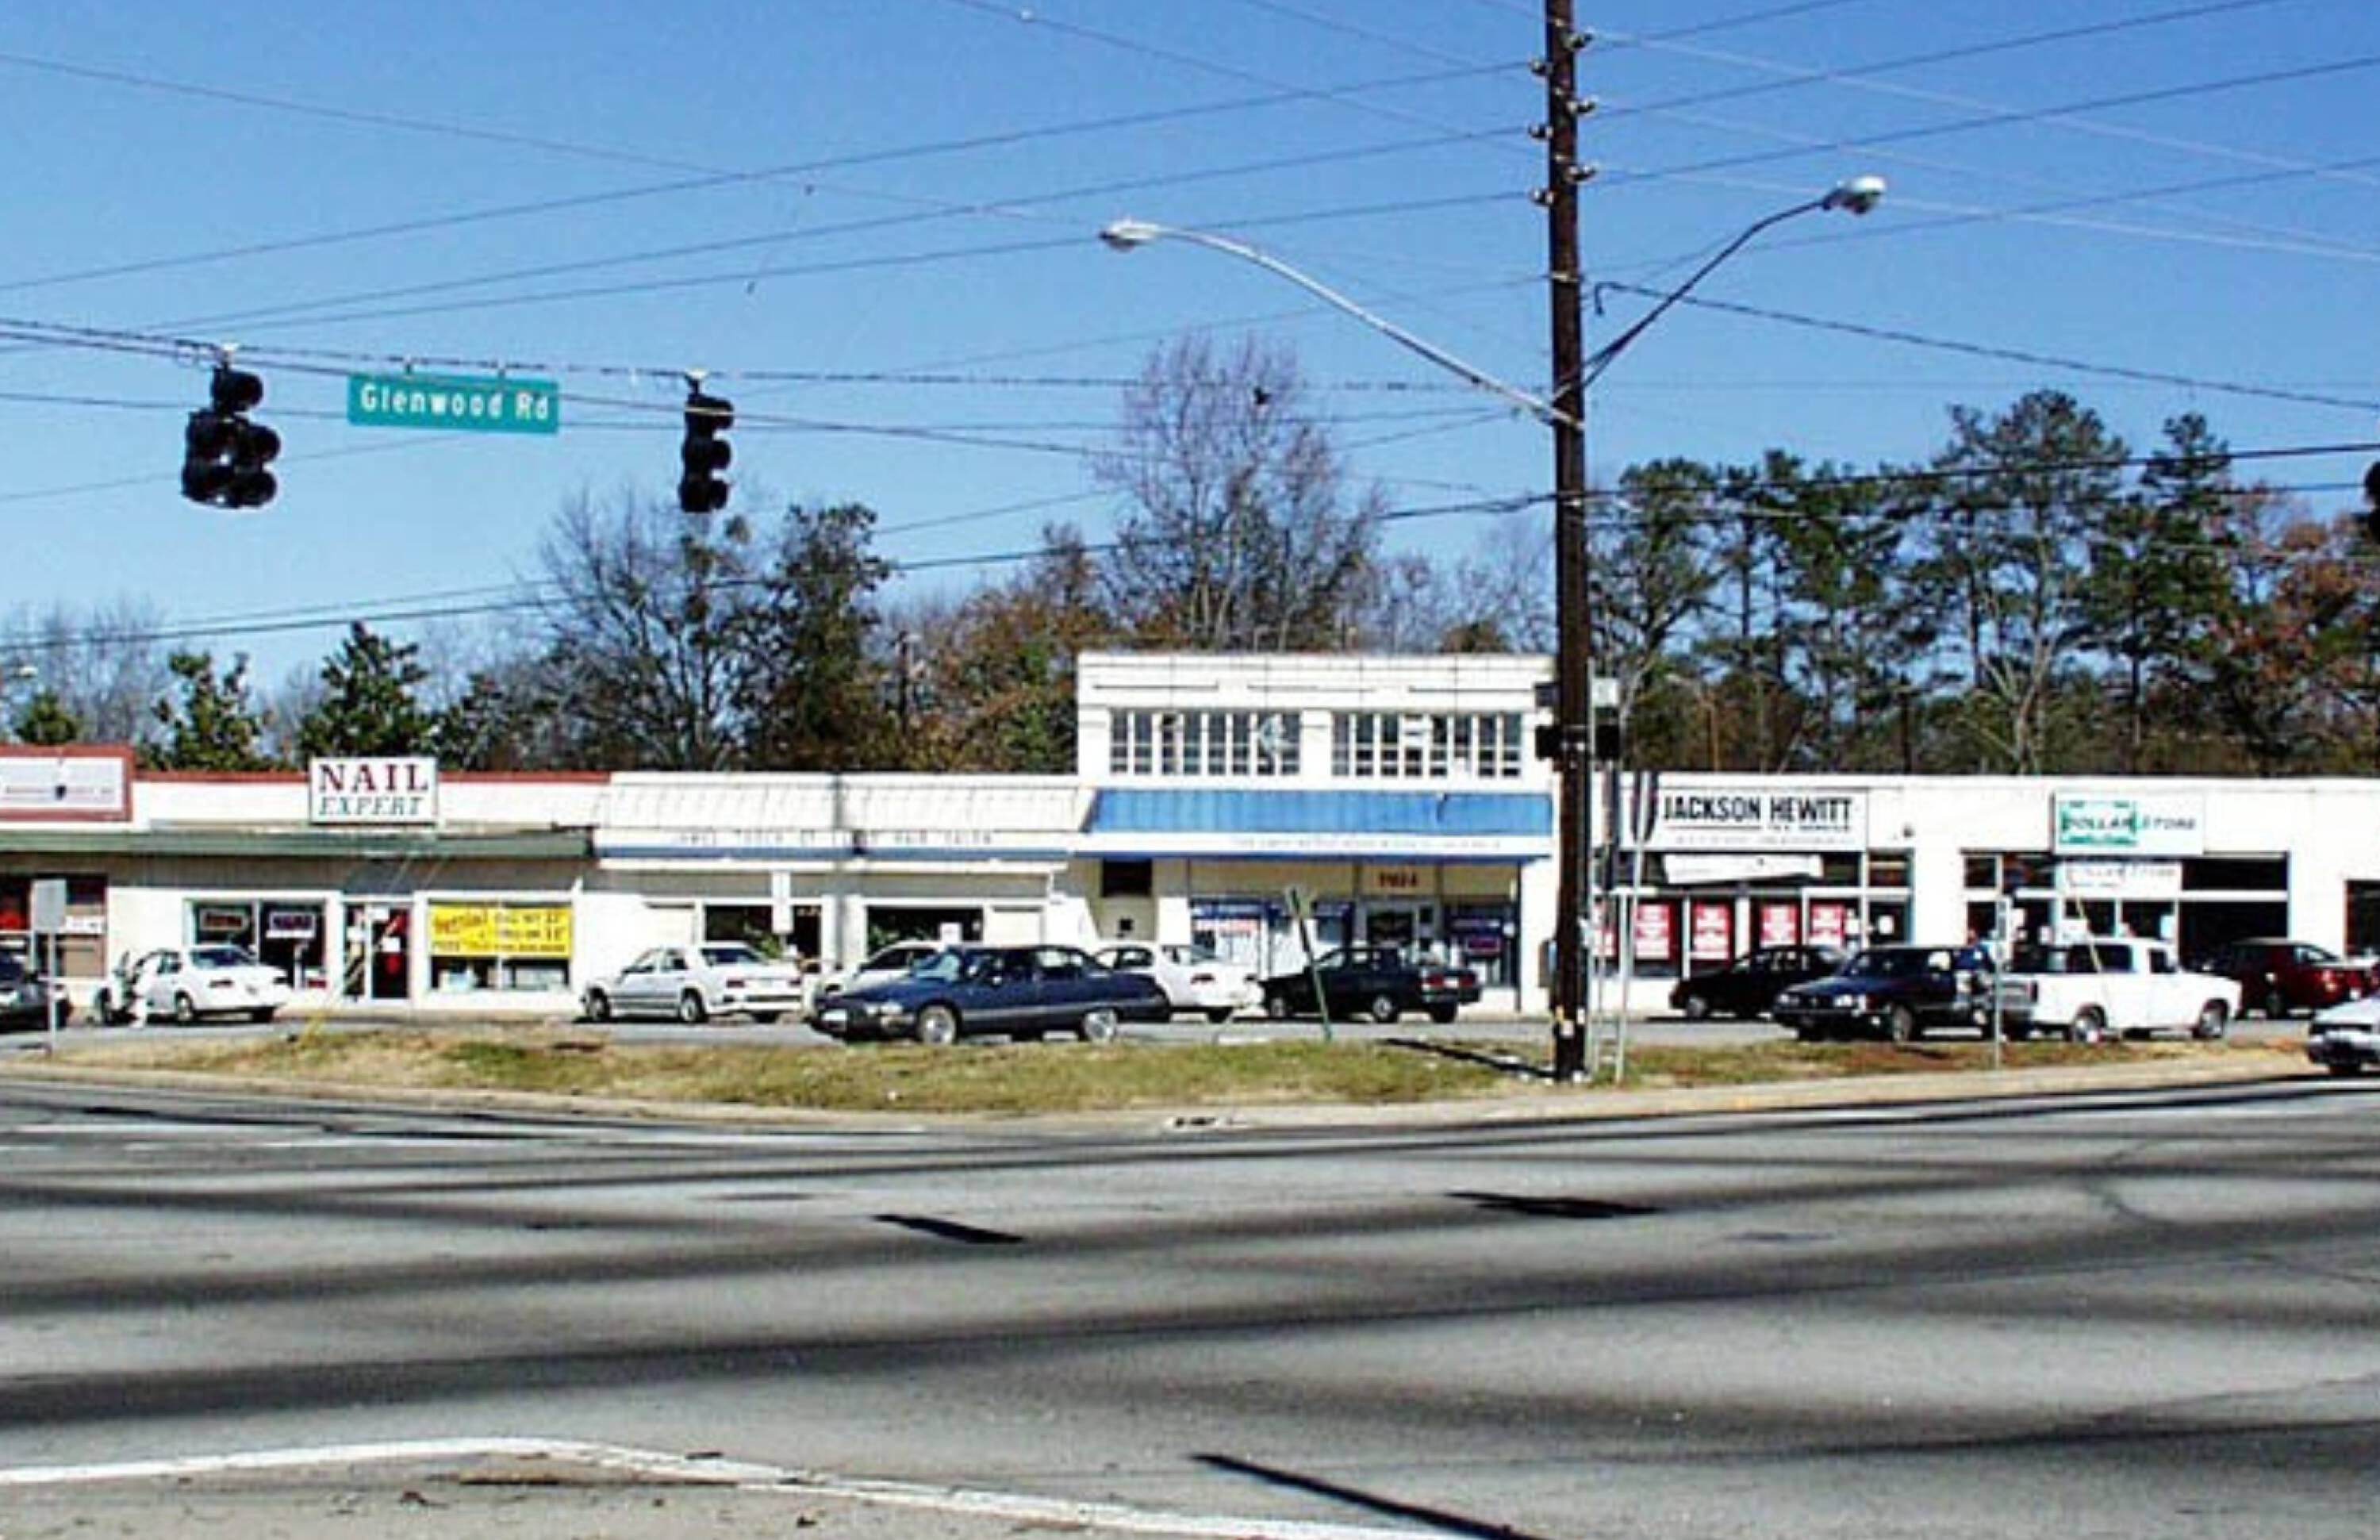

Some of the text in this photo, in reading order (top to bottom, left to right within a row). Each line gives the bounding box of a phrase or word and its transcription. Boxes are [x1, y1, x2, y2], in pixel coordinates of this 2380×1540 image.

[360, 382, 549, 421] Glenwood Rd
[319, 764, 429, 792] NAIL
[319, 796, 423, 816] EXPERT
[1664, 796, 1853, 823] JACKSON HEWITT
